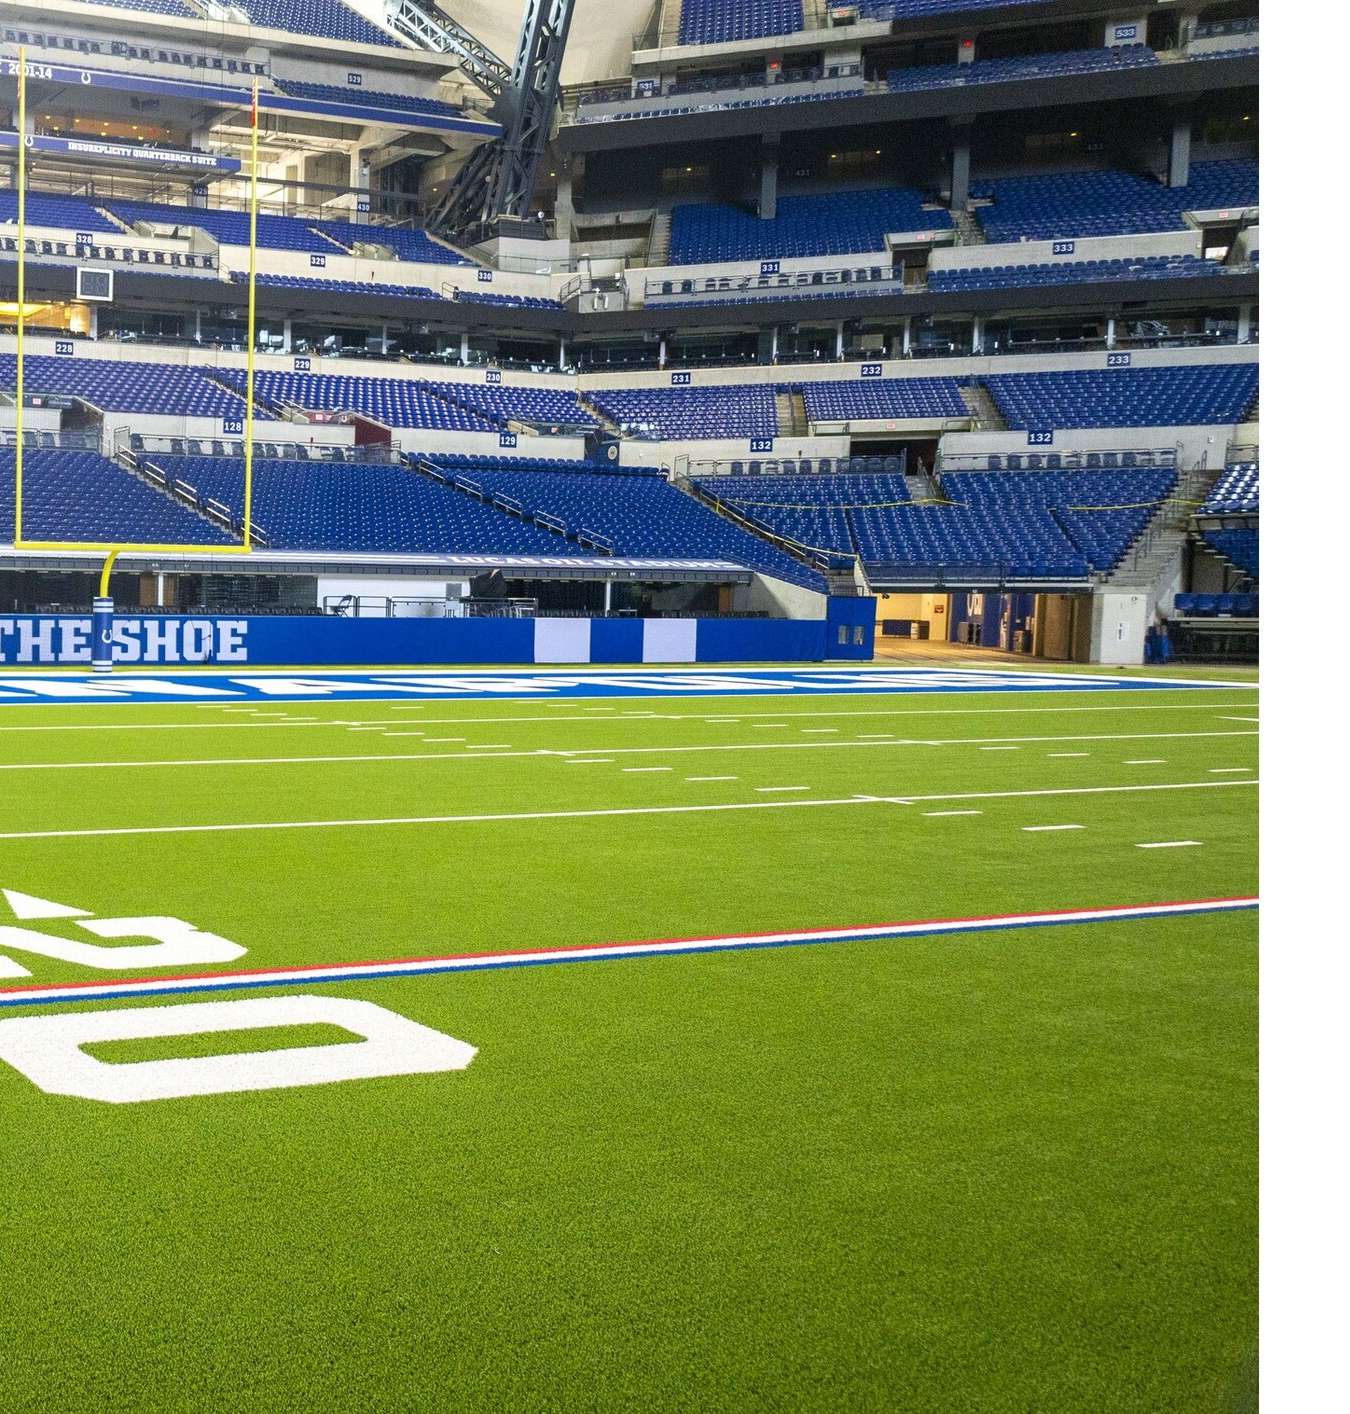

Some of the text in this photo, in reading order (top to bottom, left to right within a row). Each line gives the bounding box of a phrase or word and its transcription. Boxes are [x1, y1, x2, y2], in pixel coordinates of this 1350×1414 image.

[1115, 27, 1137, 38] 533
[348, 75, 361, 83] 529
[68, 141, 217, 166] INSUREPLICITY QUARTERBACK SUITE
[357, 203, 371, 212] 430
[76, 234, 93, 245] 328
[1053, 242, 1074, 254] 333
[311, 255, 326, 267] 329
[762, 263, 779, 273] 331
[478, 271, 492, 281] 330
[56, 342, 73, 354] 228
[294, 359, 310, 371] 229
[1108, 355, 1130, 365] 233
[861, 365, 881, 376] 232
[486, 372, 501, 383] 230
[672, 374, 690, 384] 231
[223, 421, 242, 433] 128
[499, 436, 516, 447] 129
[1028, 433, 1052, 444] 132
[750, 440, 771, 451] 132
[449, 556, 719, 569] LUCAS OIL STADIUM
[112, 620, 248, 662] SHOE
